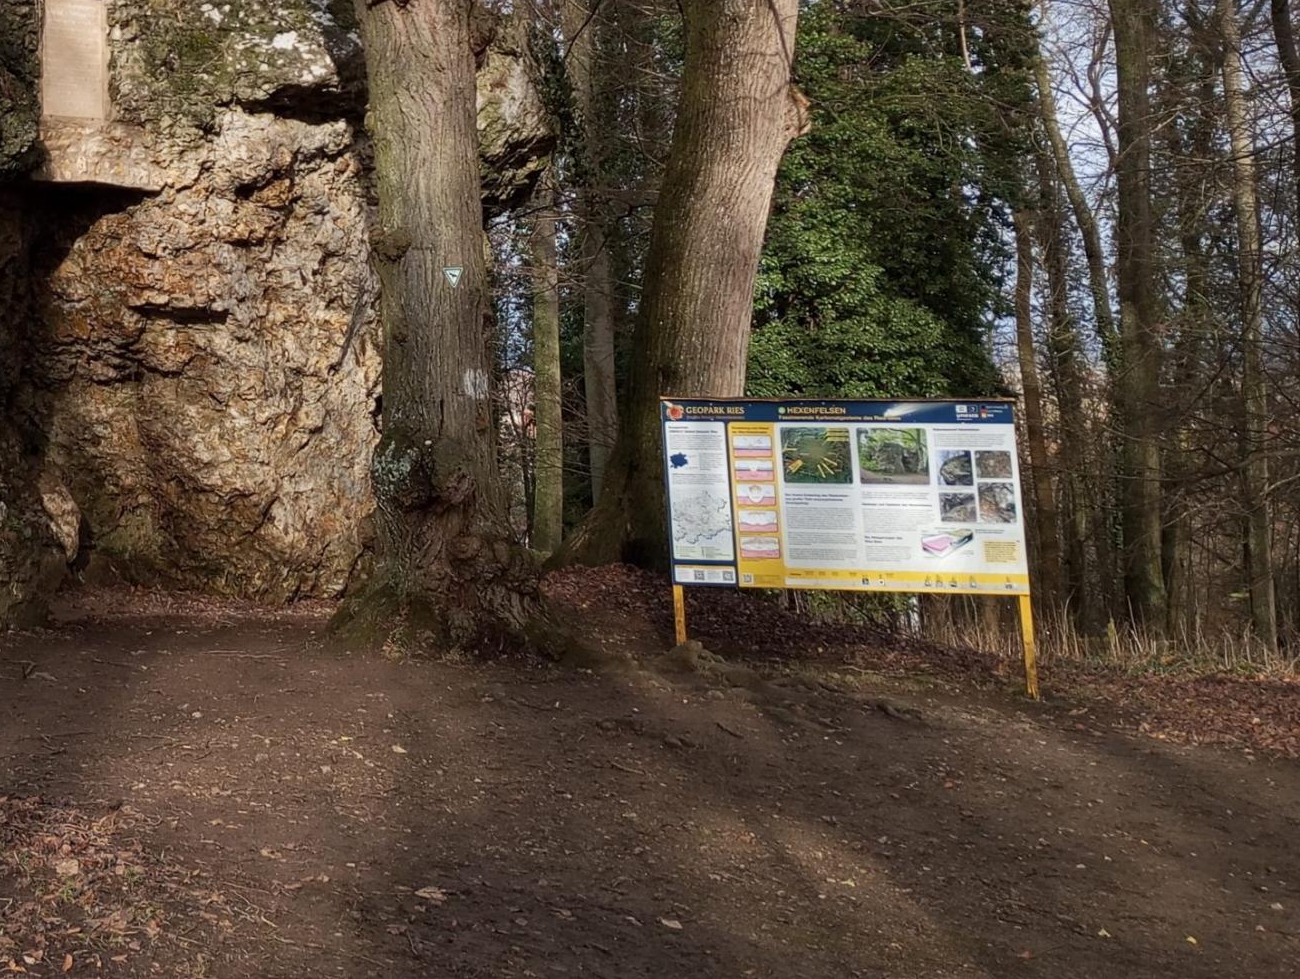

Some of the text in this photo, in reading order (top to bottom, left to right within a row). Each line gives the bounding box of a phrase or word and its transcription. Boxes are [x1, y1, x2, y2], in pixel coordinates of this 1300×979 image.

[685, 406, 745, 415] GEOPARK RIES
[786, 406, 846, 415] HEXENFELSEN
